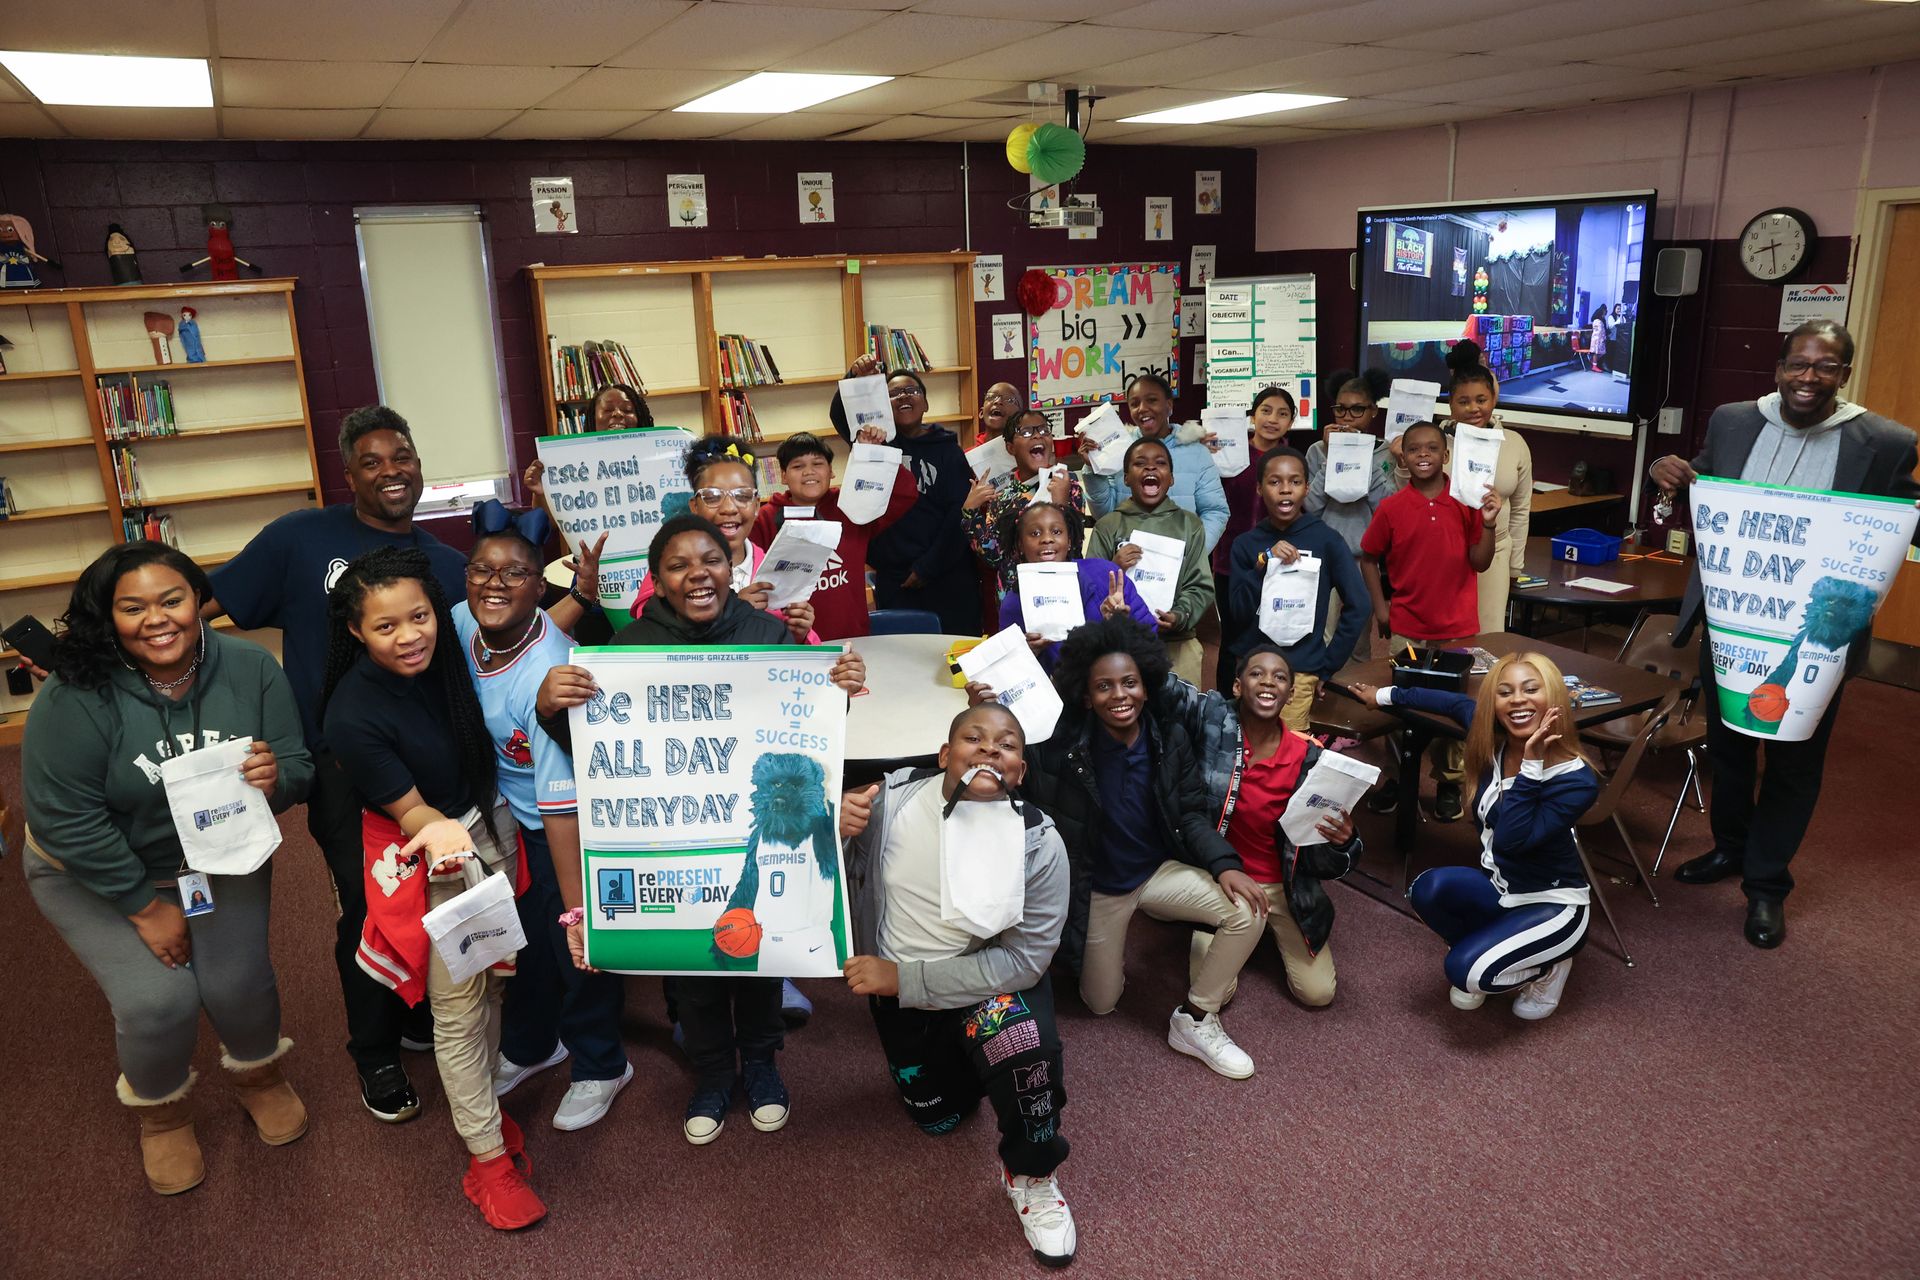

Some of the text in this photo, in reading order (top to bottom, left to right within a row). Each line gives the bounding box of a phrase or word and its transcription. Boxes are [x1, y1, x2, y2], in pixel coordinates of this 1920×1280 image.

[1396, 239, 1424, 254] BLACK
[1396, 249, 1424, 260] HISTORY
[1052, 274, 1153, 310] DREAM
[1062, 310, 1097, 348] big
[1038, 343, 1121, 380] WORK
[596, 455, 640, 480] Aquí
[659, 475, 691, 488] ÉXIT
[551, 490, 598, 512] Todo
[604, 485, 621, 506] El
[557, 518, 598, 533] Todos
[603, 514, 626, 529] Los
[1696, 504, 1811, 546] Be HERE
[1843, 512, 1900, 535] SCHOOL
[1566, 548, 1574, 559] 4
[1849, 540, 1879, 556] YOU
[1698, 542, 1806, 585] ALL DAY
[1820, 557, 1887, 582] SUCCESS
[598, 582, 625, 593] EVERY
[1702, 584, 1796, 621] VERYDAY
[666, 653, 750, 662] MEMPHIS GRIZZLIES
[1712, 640, 1768, 663] rePRESENT
[767, 668, 833, 688] SCHOOL
[1747, 662, 1771, 677] DAY
[1804, 664, 1819, 684] 0
[586, 684, 733, 725] Be HERE
[780, 702, 814, 718] YOU
[755, 729, 828, 752] SUCCESS
[588, 737, 738, 779] ALL DAY
[212, 805, 246, 822] EVERY DAY
[591, 794, 739, 828] EVERYDAY
[638, 868, 722, 886] rePRESENT
[770, 871, 785, 897] 0
[640, 885, 730, 904] EVERY DAY
